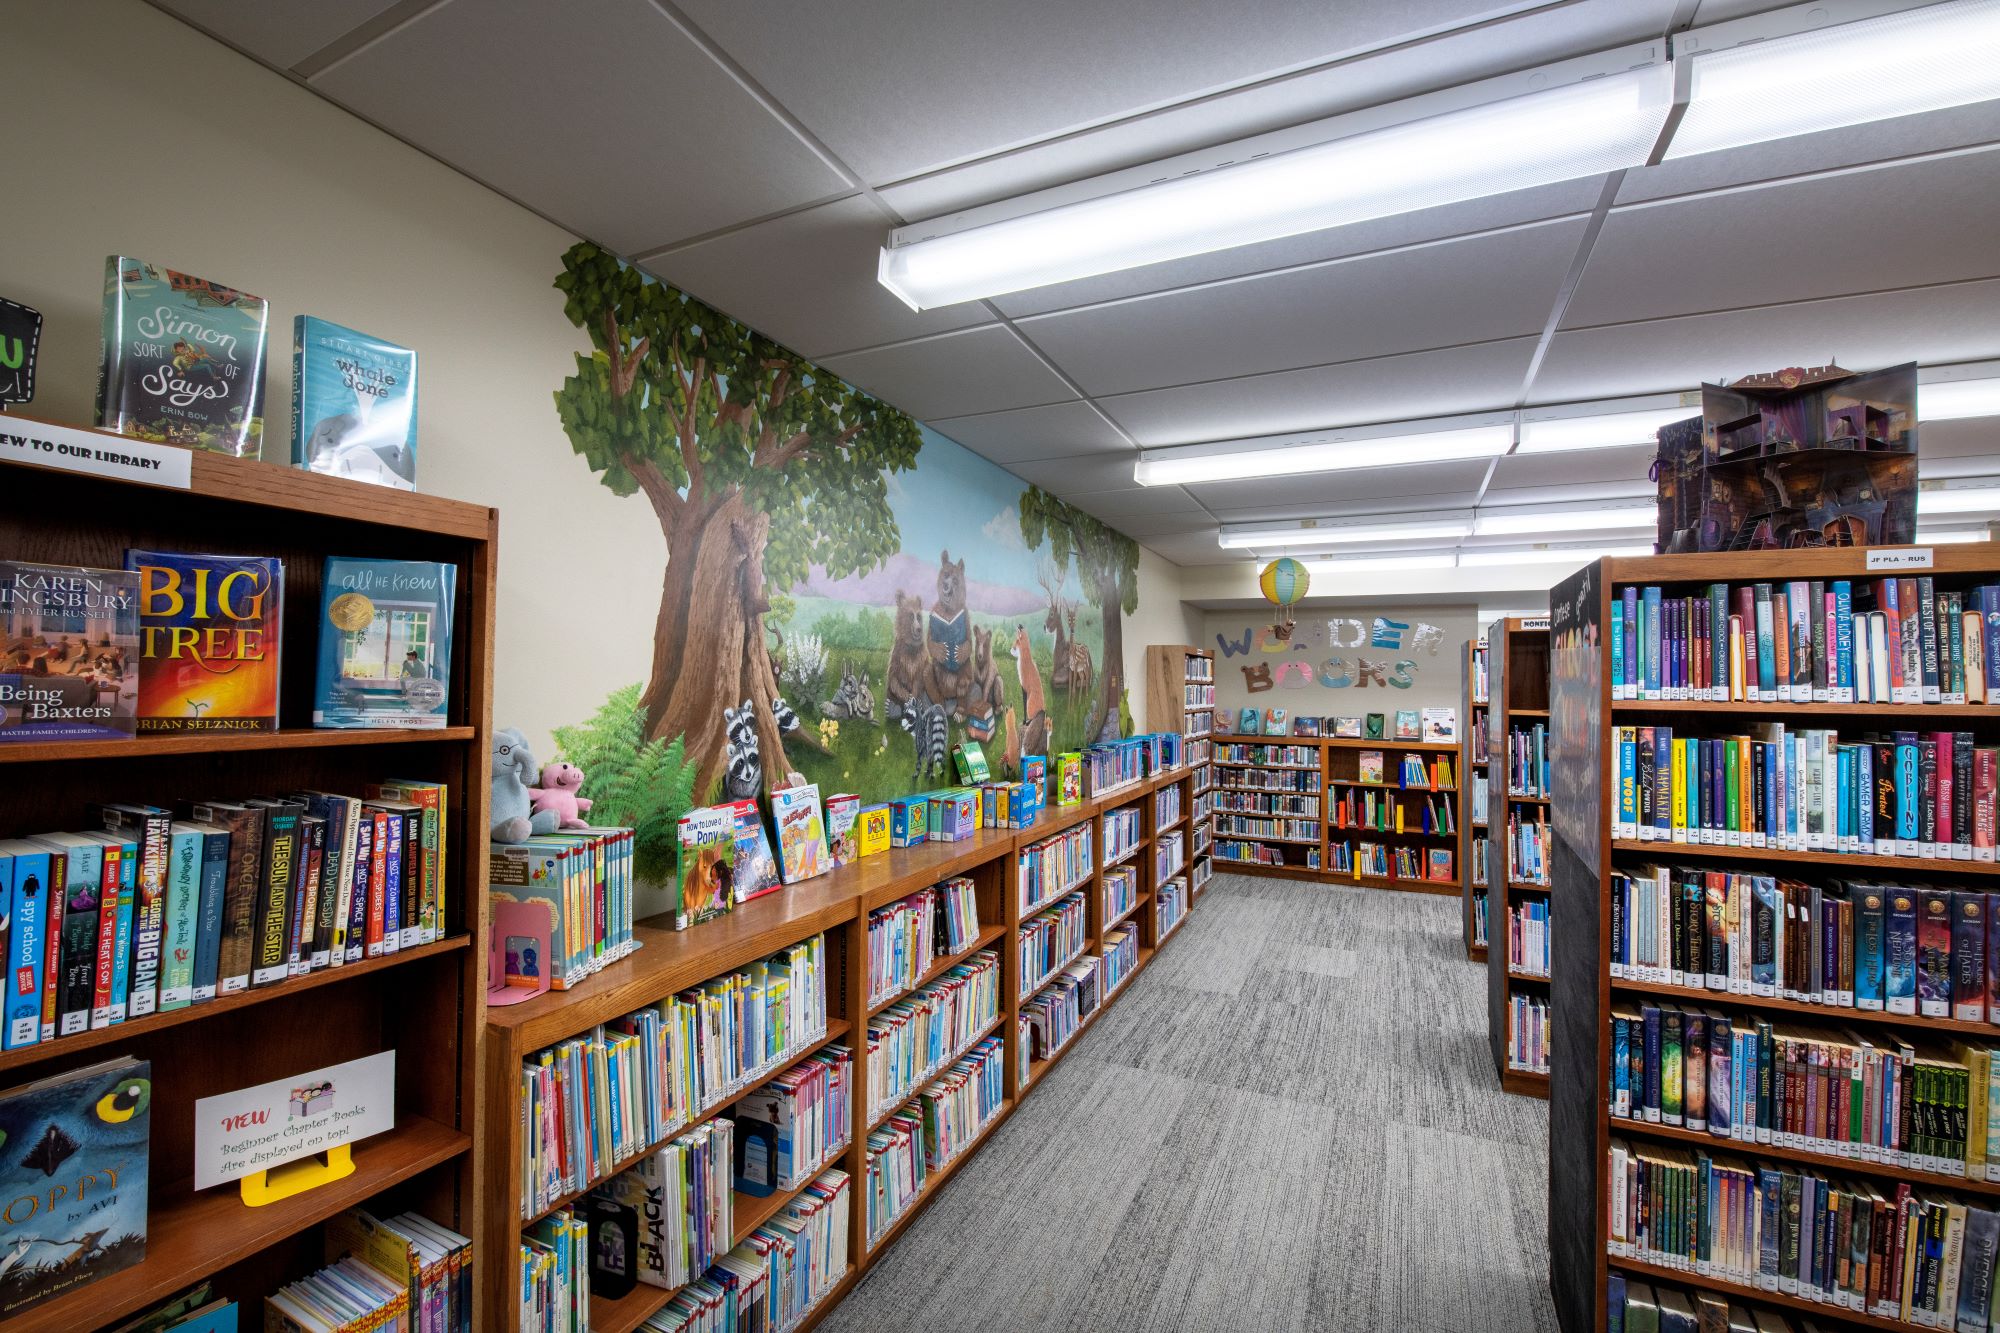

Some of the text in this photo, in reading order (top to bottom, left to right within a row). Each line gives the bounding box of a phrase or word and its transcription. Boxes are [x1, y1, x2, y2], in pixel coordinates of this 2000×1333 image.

[133, 341, 166, 359] SORT
[137, 306, 237, 361] Simon
[225, 364, 240, 380] OF
[336, 359, 397, 386] whale
[342, 374, 389, 398] done
[160, 406, 208, 421] ERIN BOW
[0, 433, 162, 470] EW TO OUR LIBRARY
[0, 588, 132, 610] INGSBURY
[14, 573, 103, 593] KAREN
[137, 562, 272, 621] BIG
[375, 577, 389, 588] HE
[21, 608, 58, 617] TYLER
[1837, 593, 1851, 652] OLIVIA KIDNEY
[1923, 621, 1934, 631] OF
[140, 626, 265, 674] TREE
[1924, 634, 1935, 650] THE
[1241, 656, 1419, 693] BOOKS
[1925, 651, 1937, 673] MOON
[0, 684, 63, 706] Being
[31, 703, 112, 719] Baxters
[187, 719, 260, 729] SELZNICK
[1623, 776, 1633, 813] WOOF
[1860, 772, 1870, 837] GAMER ARMY
[1878, 778, 1894, 820] Pirates!
[1904, 747, 1914, 836] GOBLINS
[160, 819, 170, 834] LUCY
[376, 821, 386, 838] SAM
[409, 819, 418, 840] ADAM
[686, 820, 698, 832] How
[697, 830, 719, 847] Pony
[143, 818, 161, 876] HAWKING
[157, 840, 168, 874] STEPHEN
[375, 839, 385, 853] WU
[354, 826, 370, 923] SAM WU NOT SPACE
[389, 820, 400, 918] SAM WU NOT ZOMBIES
[207, 871, 221, 907] Troubling
[263, 836, 291, 965] THE SUN AND THE STAR
[304, 867, 320, 940] THE BRONZE PEN
[320, 851, 340, 928] DEAD WEDNESDAY
[375, 883, 384, 911] SPIDERS
[150, 897, 162, 931] GEORGE
[21, 900, 38, 967] spy school
[1688, 902, 1702, 974] STORY THIEVES
[101, 921, 112, 984] THE HEAT IS ON
[1712, 936, 1722, 969] THIEVES
[1889, 931, 1903, 978] NEPTUNE
[1959, 950, 1972, 985] HADES
[134, 963, 158, 992] BAN
[1900, 1076, 1912, 1144] Twisted Summer
[220, 1105, 366, 1156] Beginner Chapter Books
[220, 1125, 350, 1173] Are displayed on top!
[2, 1161, 129, 1225] OPPY
[67, 1195, 118, 1222] by AVI
[1927, 1259, 1938, 1284] PICTURE
[1978, 1238, 1993, 1316] DIVERGENT
[1925, 1296, 1935, 1311] GON
